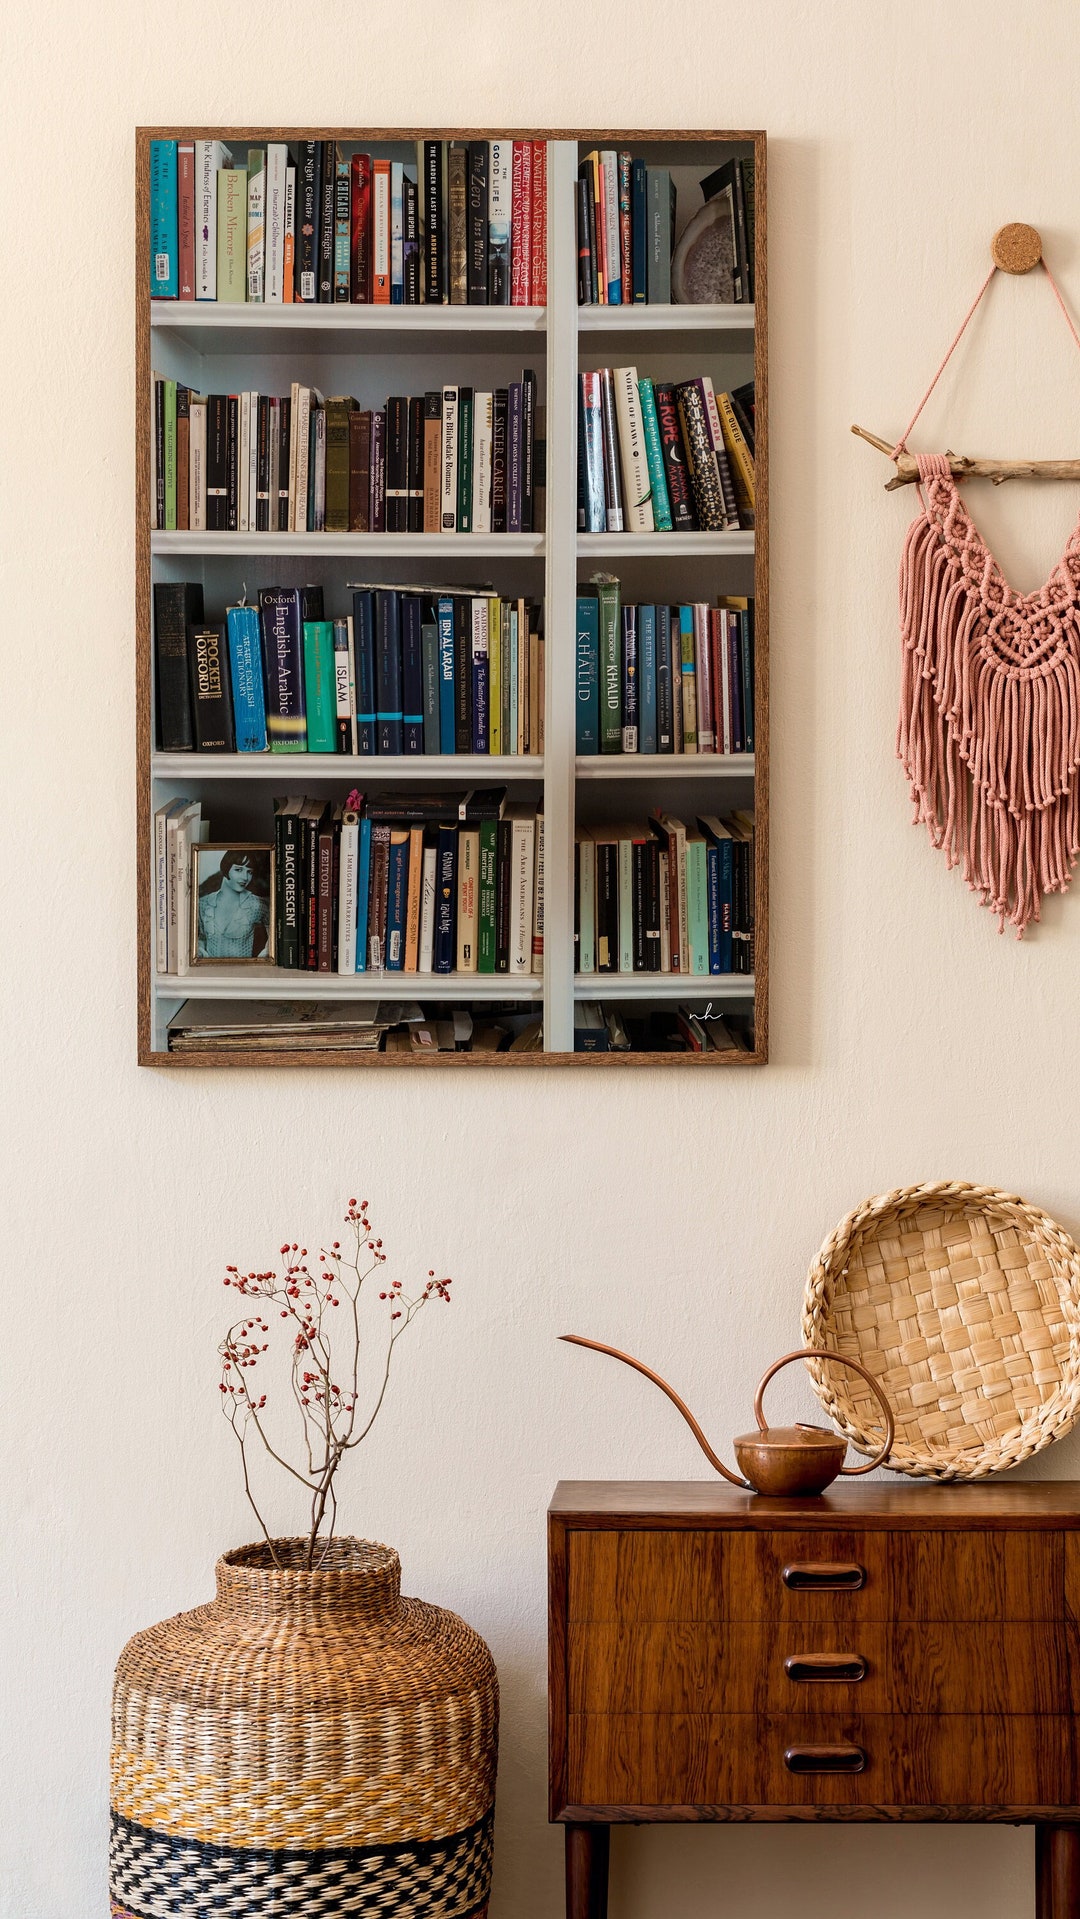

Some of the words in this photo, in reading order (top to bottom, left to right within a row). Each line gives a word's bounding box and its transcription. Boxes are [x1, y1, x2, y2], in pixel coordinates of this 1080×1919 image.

[204, 141, 212, 152] The
[474, 155, 483, 172] The
[305, 159, 314, 181] Night
[513, 147, 522, 198] JONATHAN
[522, 146, 530, 190] EXTREMELY
[533, 146, 542, 198] JONATHAN
[227, 175, 239, 212] Broken
[305, 187, 315, 218] Counter
[323, 185, 333, 223] Brooklyn
[337, 181, 348, 217] CHICAGO
[431, 187, 436, 195] OF
[471, 175, 485, 207] Zero
[227, 216, 238, 255] Mirrors
[474, 217, 483, 236] Jess
[513, 200, 521, 243] SAFRAN
[533, 200, 542, 242] SAFRAN
[323, 226, 332, 259] Heights
[474, 240, 484, 270] Walter
[512, 245, 521, 286] FOER
[521, 262, 529, 287] CLOSE
[532, 245, 541, 285] FOER
[625, 372, 633, 403] NORTH
[707, 390, 716, 414] WAR
[446, 406, 454, 420] The
[629, 407, 635, 418] OF
[645, 399, 653, 413] The
[722, 400, 732, 415] THE
[728, 418, 742, 443] QUEUE
[300, 410, 308, 444] CHARLOTTE
[445, 422, 454, 460] Blithedale
[494, 417, 504, 453] SISTER
[630, 422, 638, 446] DAWN
[648, 417, 657, 451] Baghdad
[662, 405, 679, 445] ROPE
[690, 393, 708, 463] GUAPA
[711, 416, 720, 442] PORN
[299, 470, 307, 496] GILMAN
[445, 462, 453, 495] Romance
[494, 459, 504, 505] CARRIE
[654, 454, 662, 479] Clock
[677, 466, 688, 500] KANAN
[669, 465, 681, 504] MAKIYA
[265, 595, 296, 605] Oxford
[442, 619, 451, 636] IBN
[443, 637, 453, 648] AL
[196, 639, 209, 692] OXFORD
[207, 638, 221, 690] POCKET
[236, 645, 246, 697] DICTIONARY
[578, 632, 590, 701] KHALID
[336, 665, 347, 702] ISLAM
[476, 681, 485, 710] Butterfly's
[607, 665, 618, 710] KHALID
[285, 844, 295, 875] BLACK
[320, 849, 328, 897] ZEITOUN
[345, 854, 354, 898] IMMIGRANT
[486, 852, 495, 885] Becoming
[520, 854, 528, 875] ARAB
[285, 879, 296, 927] CRESCENT
[519, 877, 527, 921] AMERICANS
[345, 899, 353, 942] NARRATIVES
[722, 903, 730, 932] BANJO
[688, 1002, 723, 1020] nh
